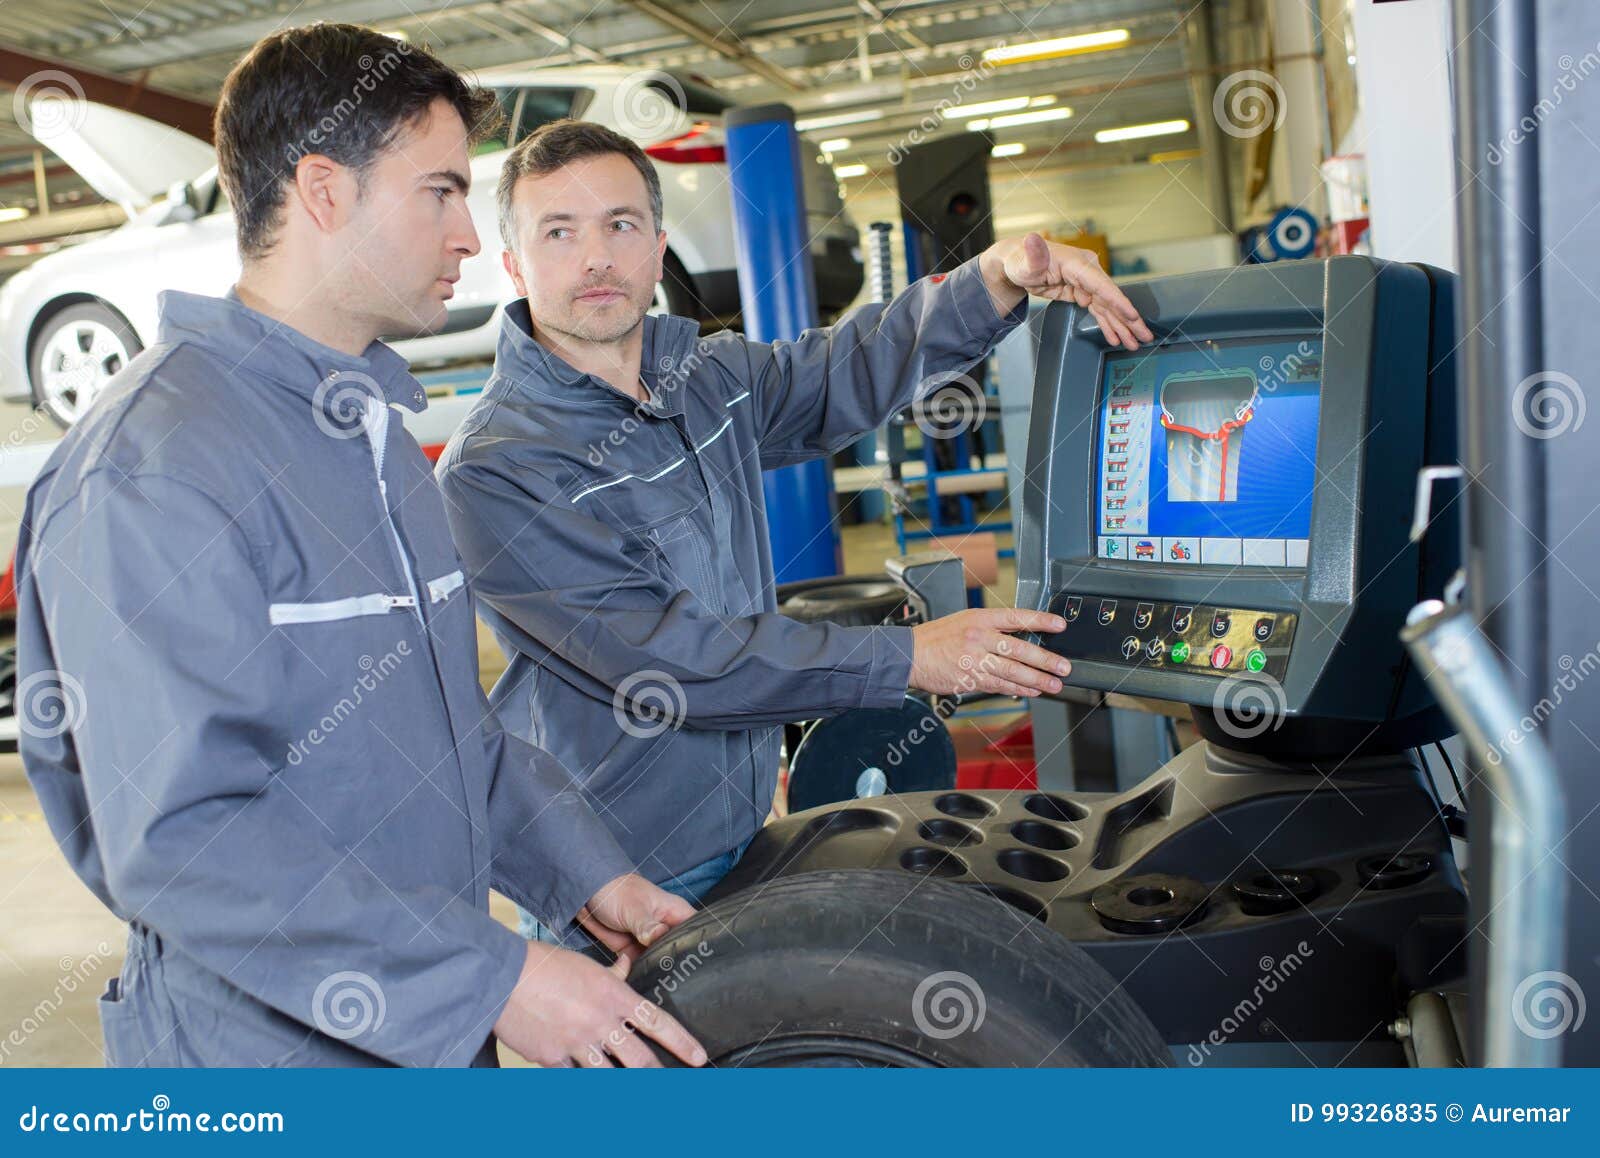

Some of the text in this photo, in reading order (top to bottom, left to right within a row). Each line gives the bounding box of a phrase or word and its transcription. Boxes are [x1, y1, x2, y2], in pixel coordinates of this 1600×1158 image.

[1101, 611, 1110, 620] 2
[1137, 614, 1146, 624] 3
[1175, 618, 1185, 627] 4
[1215, 621, 1226, 631] 5
[1257, 625, 1269, 636] 6
